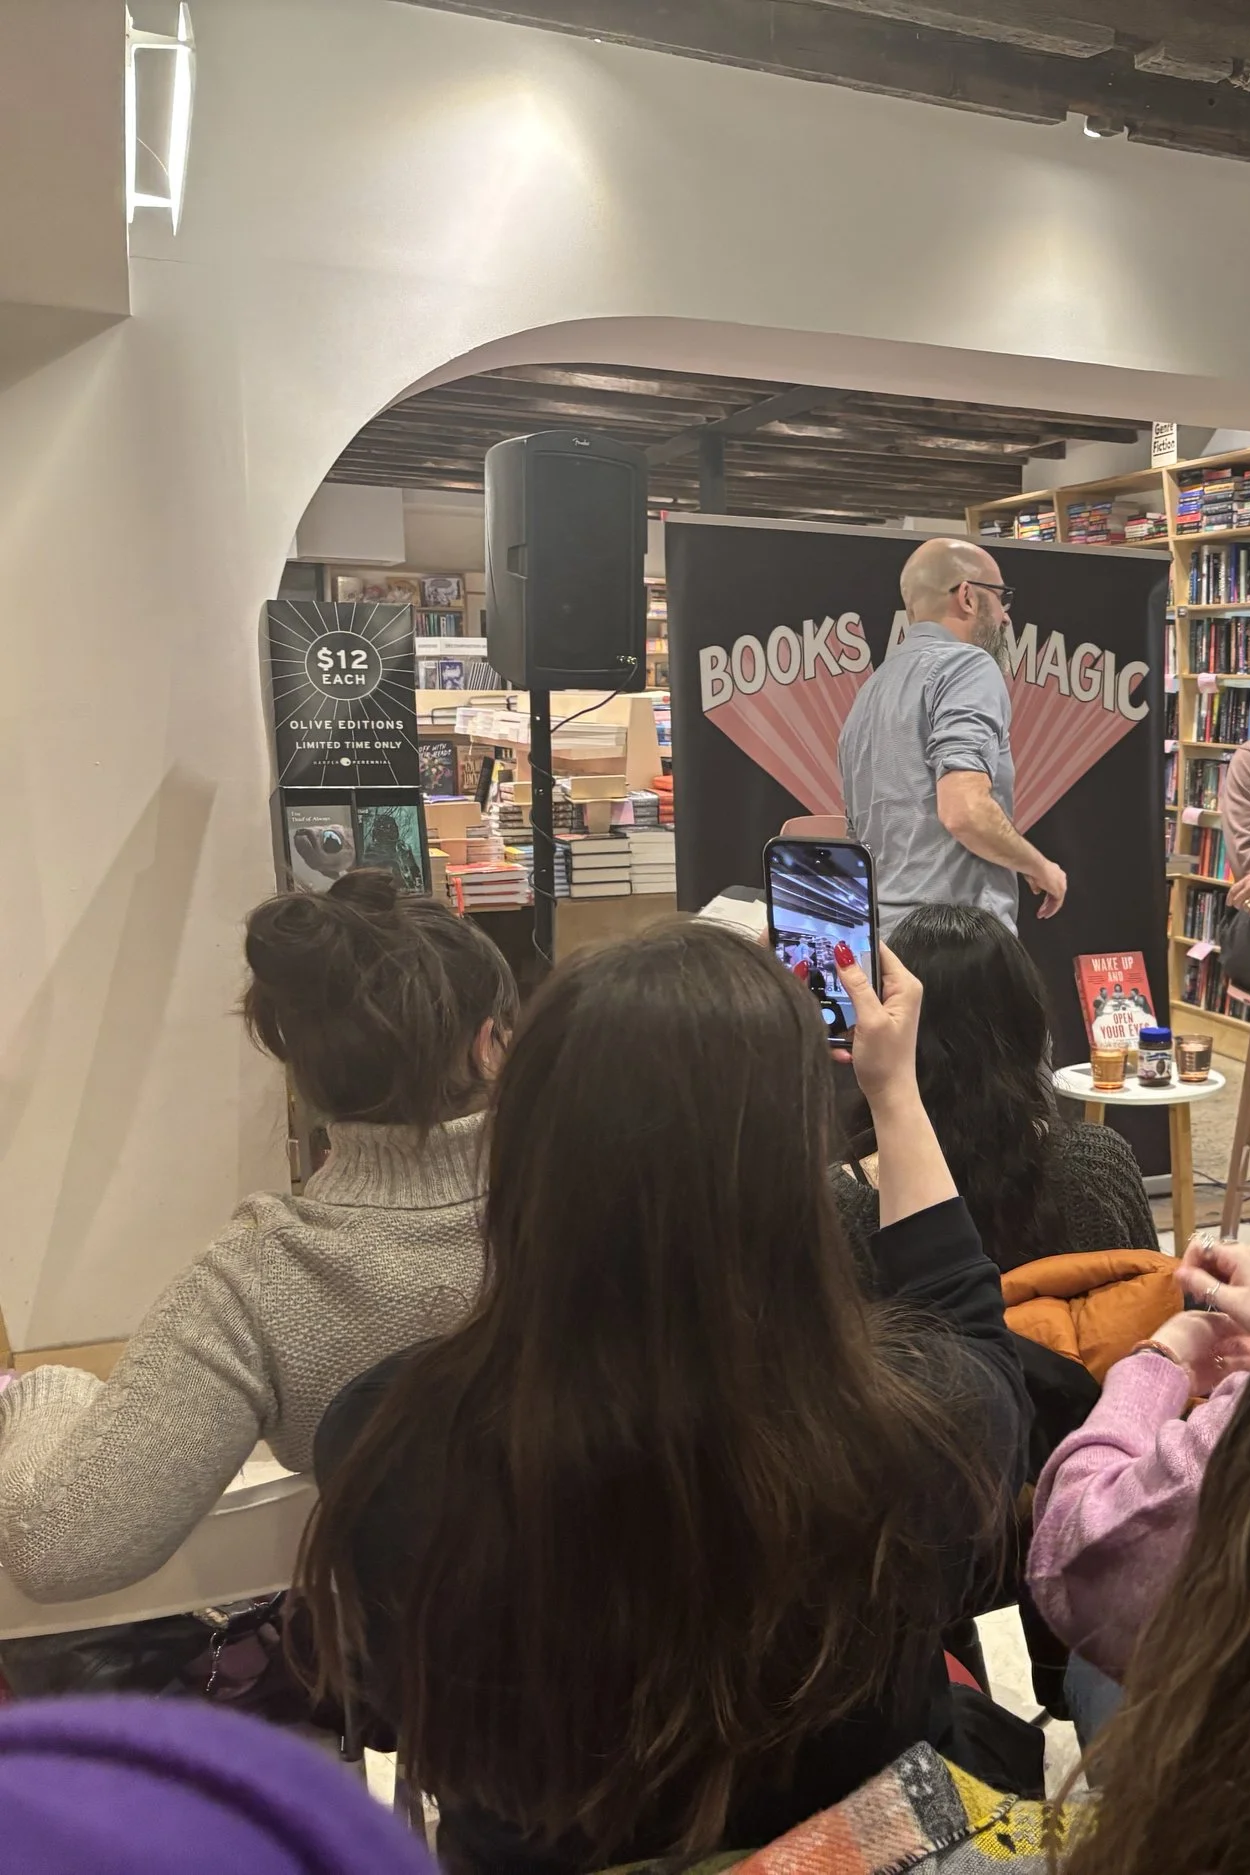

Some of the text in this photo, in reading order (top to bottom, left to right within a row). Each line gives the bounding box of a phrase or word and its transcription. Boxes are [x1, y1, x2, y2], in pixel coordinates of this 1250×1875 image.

[317, 646, 369, 671] $12
[699, 611, 872, 714] BOOKS
[1006, 621, 1150, 722] MAGIC
[322, 674, 366, 685] EACH
[290, 720, 404, 730] OLIVE EDITIONS
[296, 741, 402, 749] LIMITED TIME ONLY
[1091, 956, 1134, 972] WAKE UP
[1107, 971, 1124, 982] AND
[1112, 1012, 1134, 1024] OPEN
[1100, 1024, 1125, 1039] YOUR
